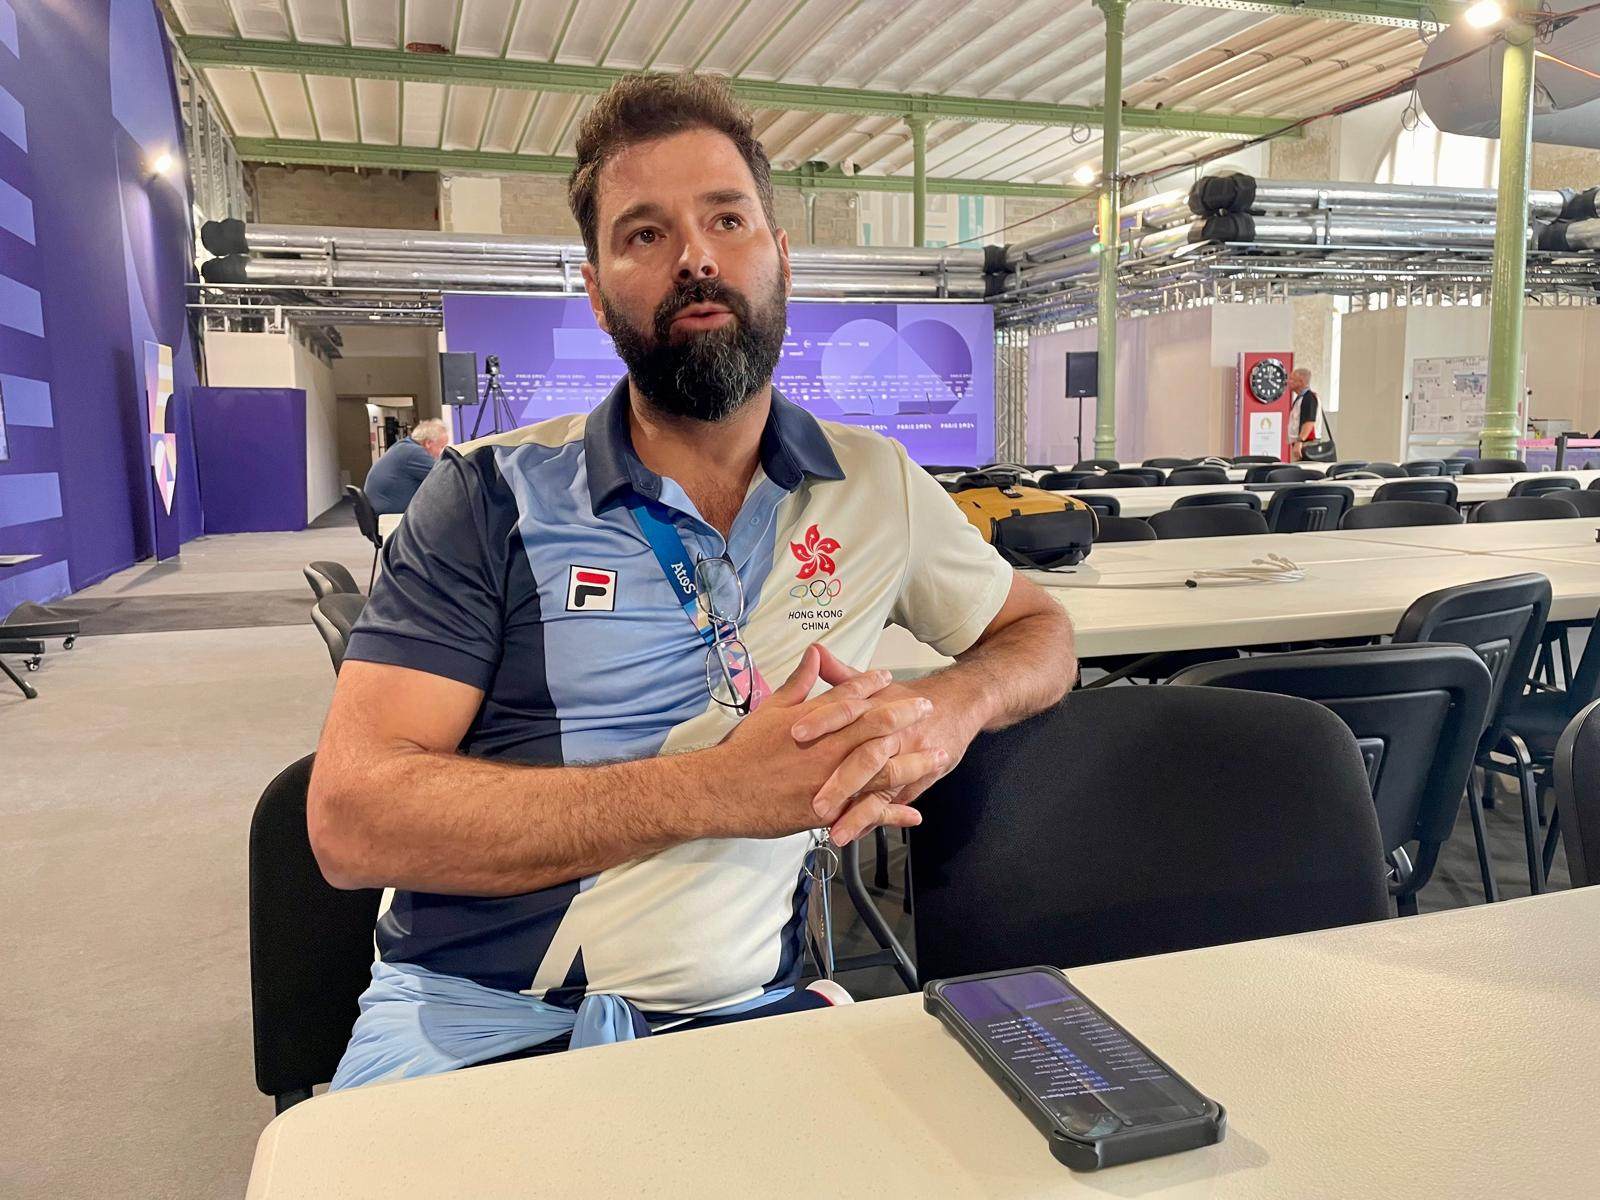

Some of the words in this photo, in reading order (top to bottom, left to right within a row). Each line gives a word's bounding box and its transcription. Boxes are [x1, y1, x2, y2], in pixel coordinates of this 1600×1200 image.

[788, 610, 814, 619] HONG
[816, 609, 843, 619] KONG
[801, 622, 830, 630] CHINA
